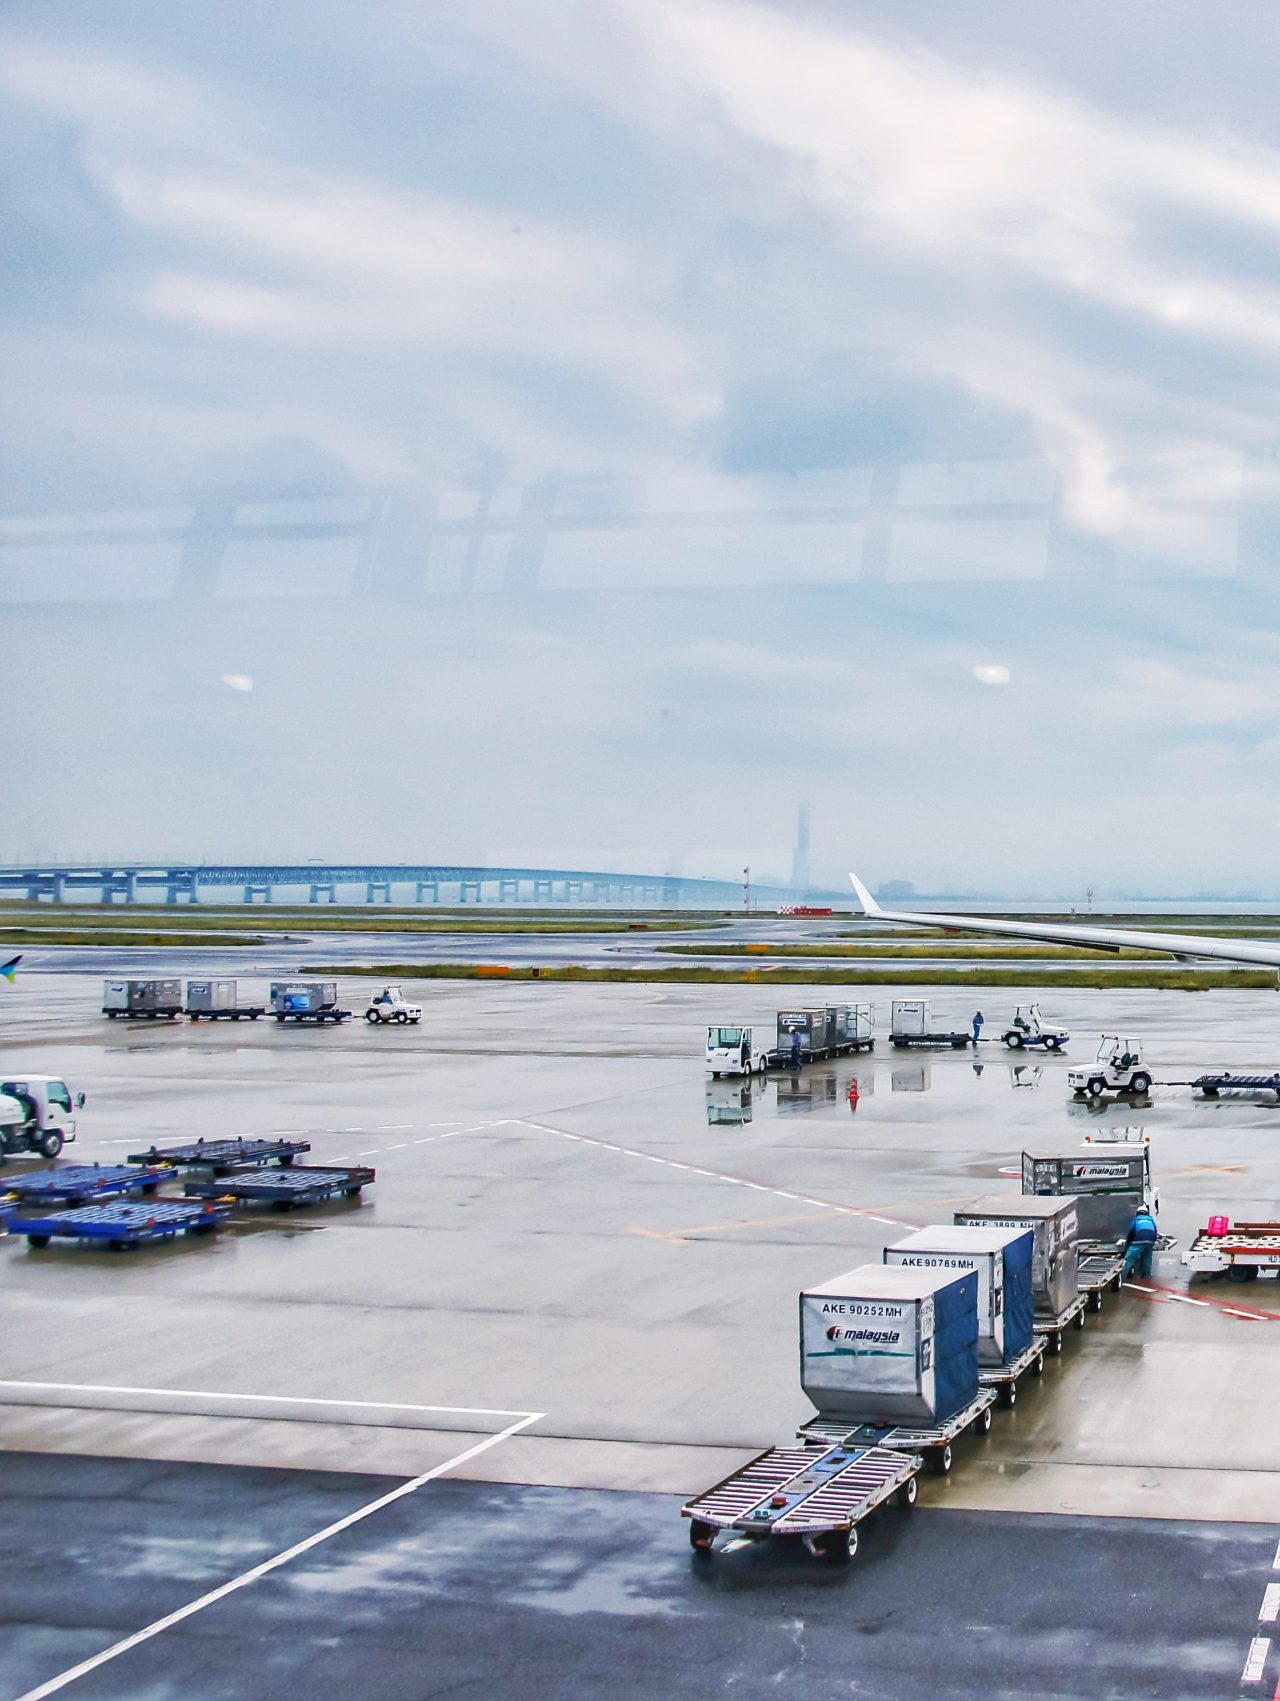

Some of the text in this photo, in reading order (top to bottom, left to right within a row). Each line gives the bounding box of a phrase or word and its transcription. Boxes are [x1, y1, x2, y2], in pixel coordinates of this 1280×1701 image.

[1088, 1167, 1127, 1176] malaysia
[901, 1257, 922, 1267] AKE
[822, 1303, 846, 1314] AKE
[844, 1329, 900, 1343] malaysia
